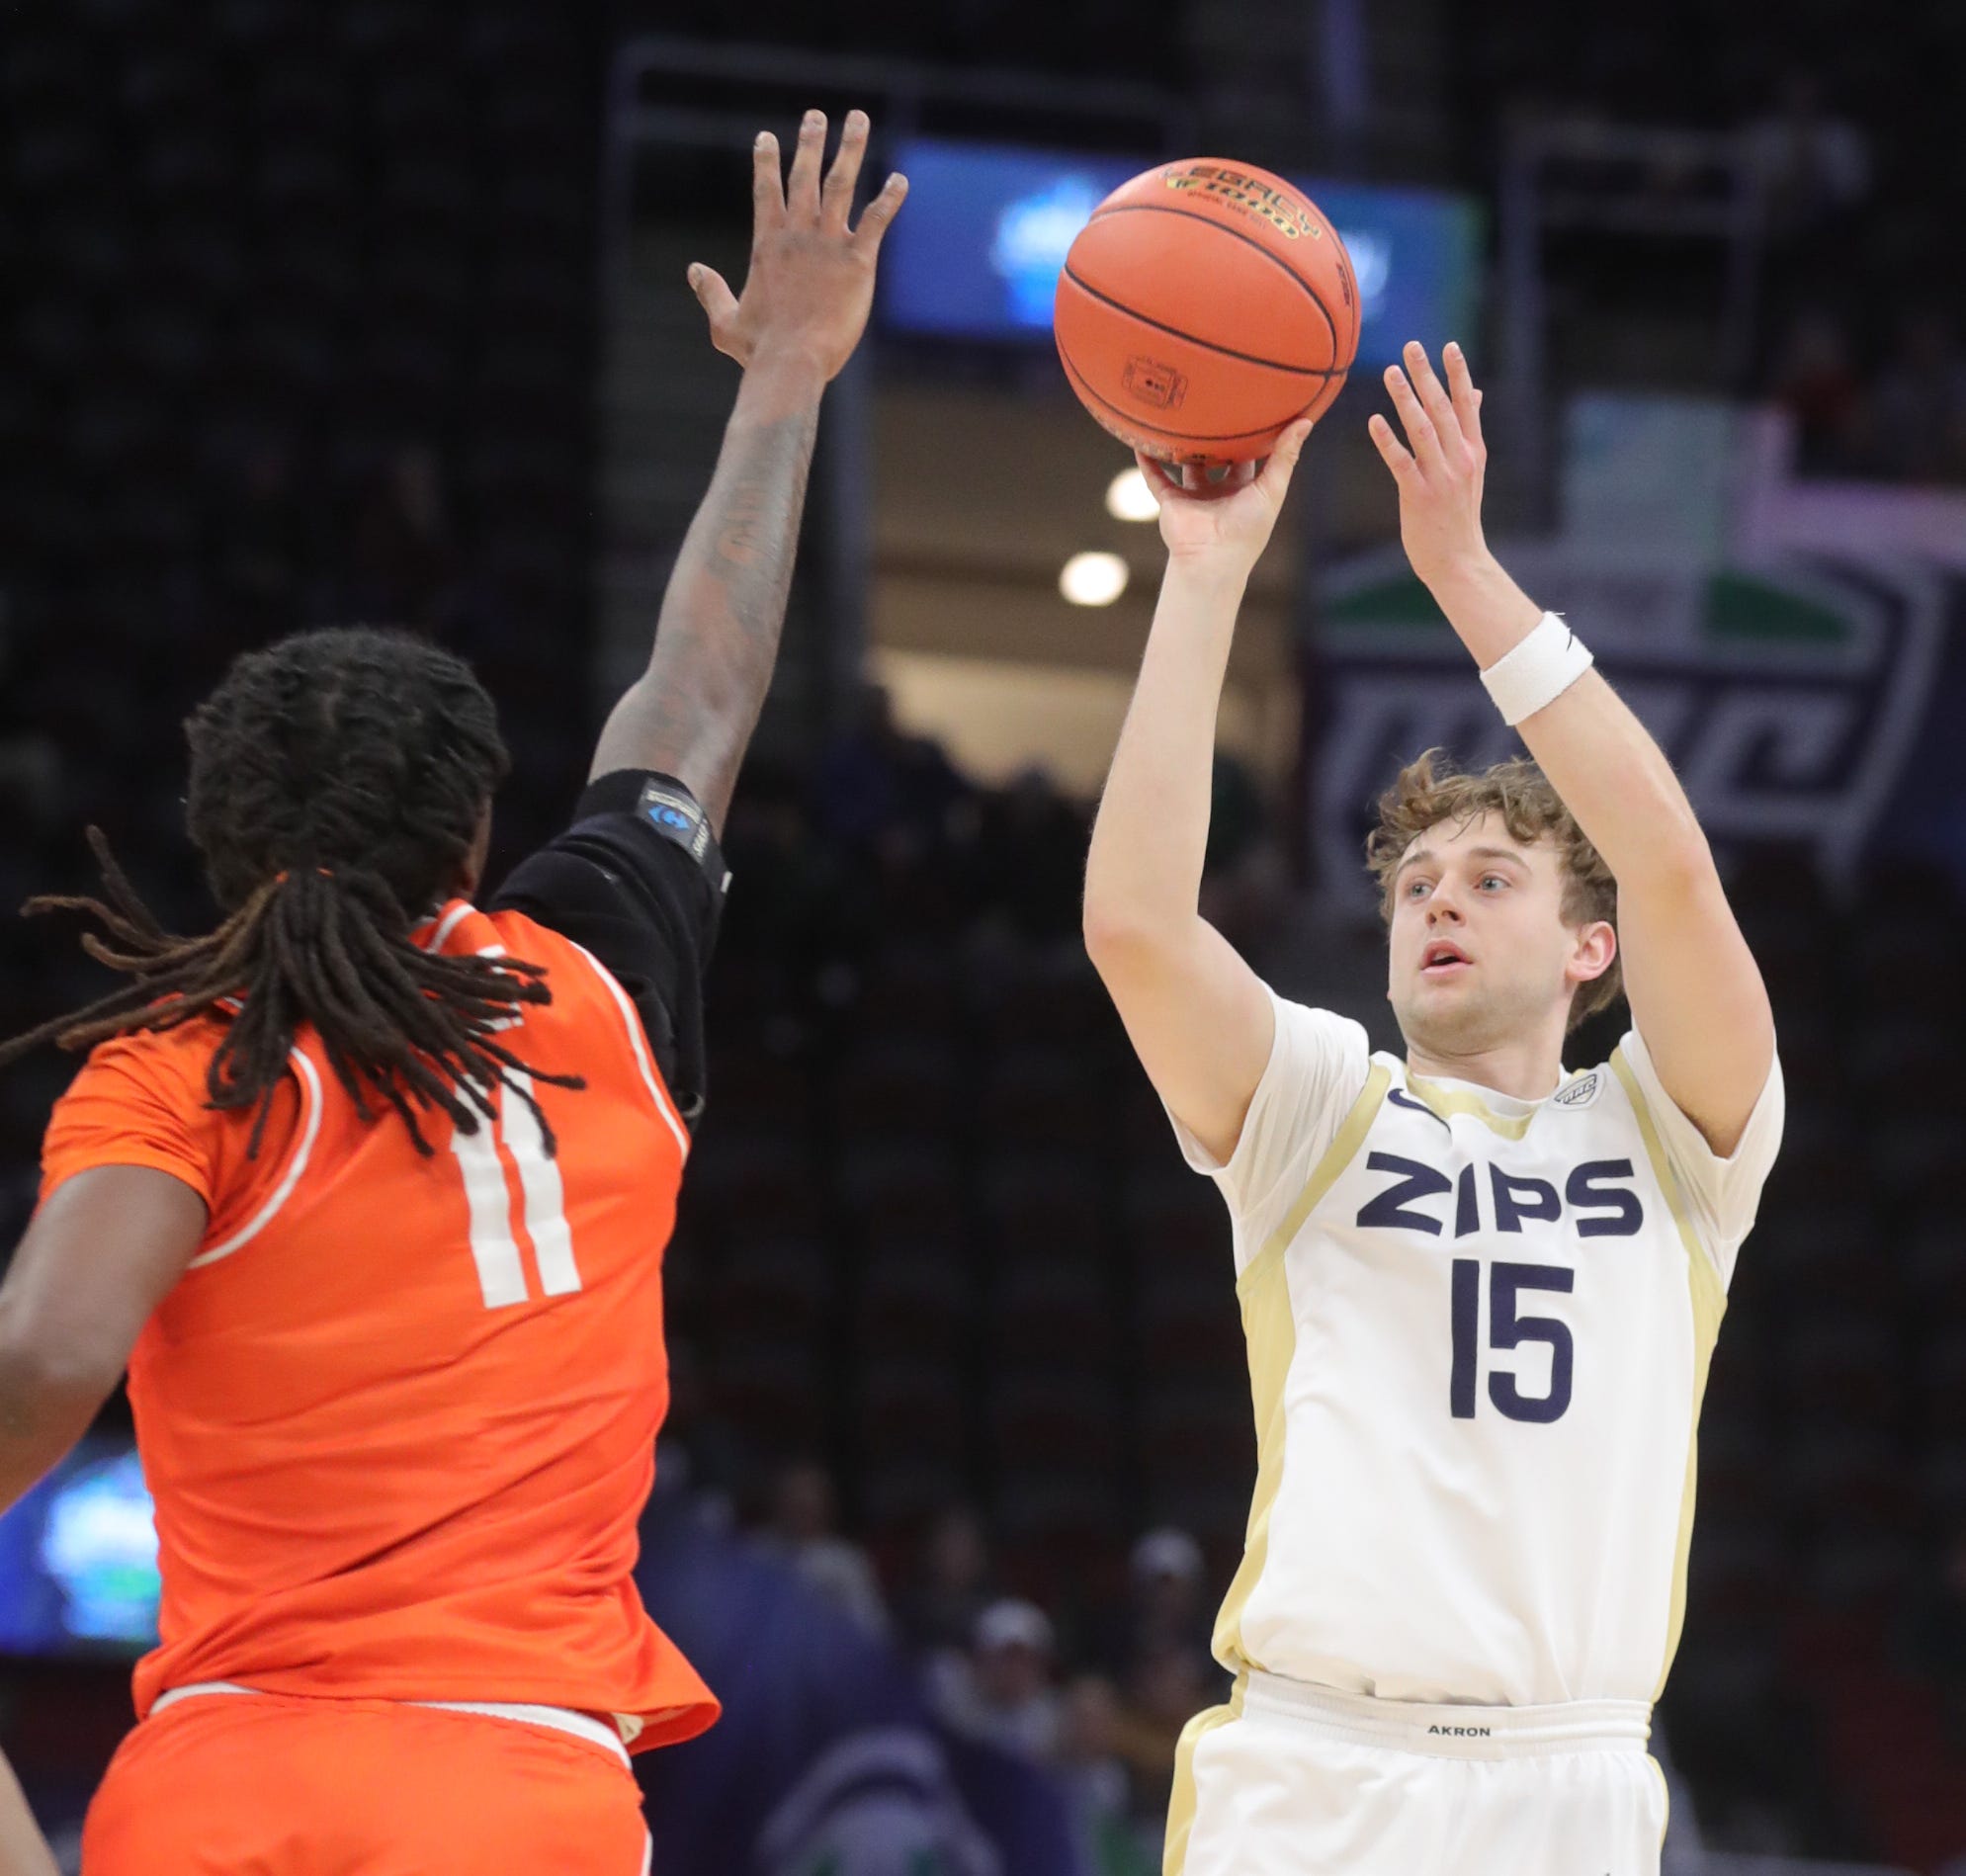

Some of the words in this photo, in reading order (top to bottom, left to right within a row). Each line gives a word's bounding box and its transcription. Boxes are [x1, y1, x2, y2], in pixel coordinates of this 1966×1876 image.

[451, 1062, 582, 1310] 11
[1356, 1151, 1644, 1238] ZIPS
[1450, 1258, 1575, 1424] 15
[1427, 1725, 1491, 1737] AKRON
